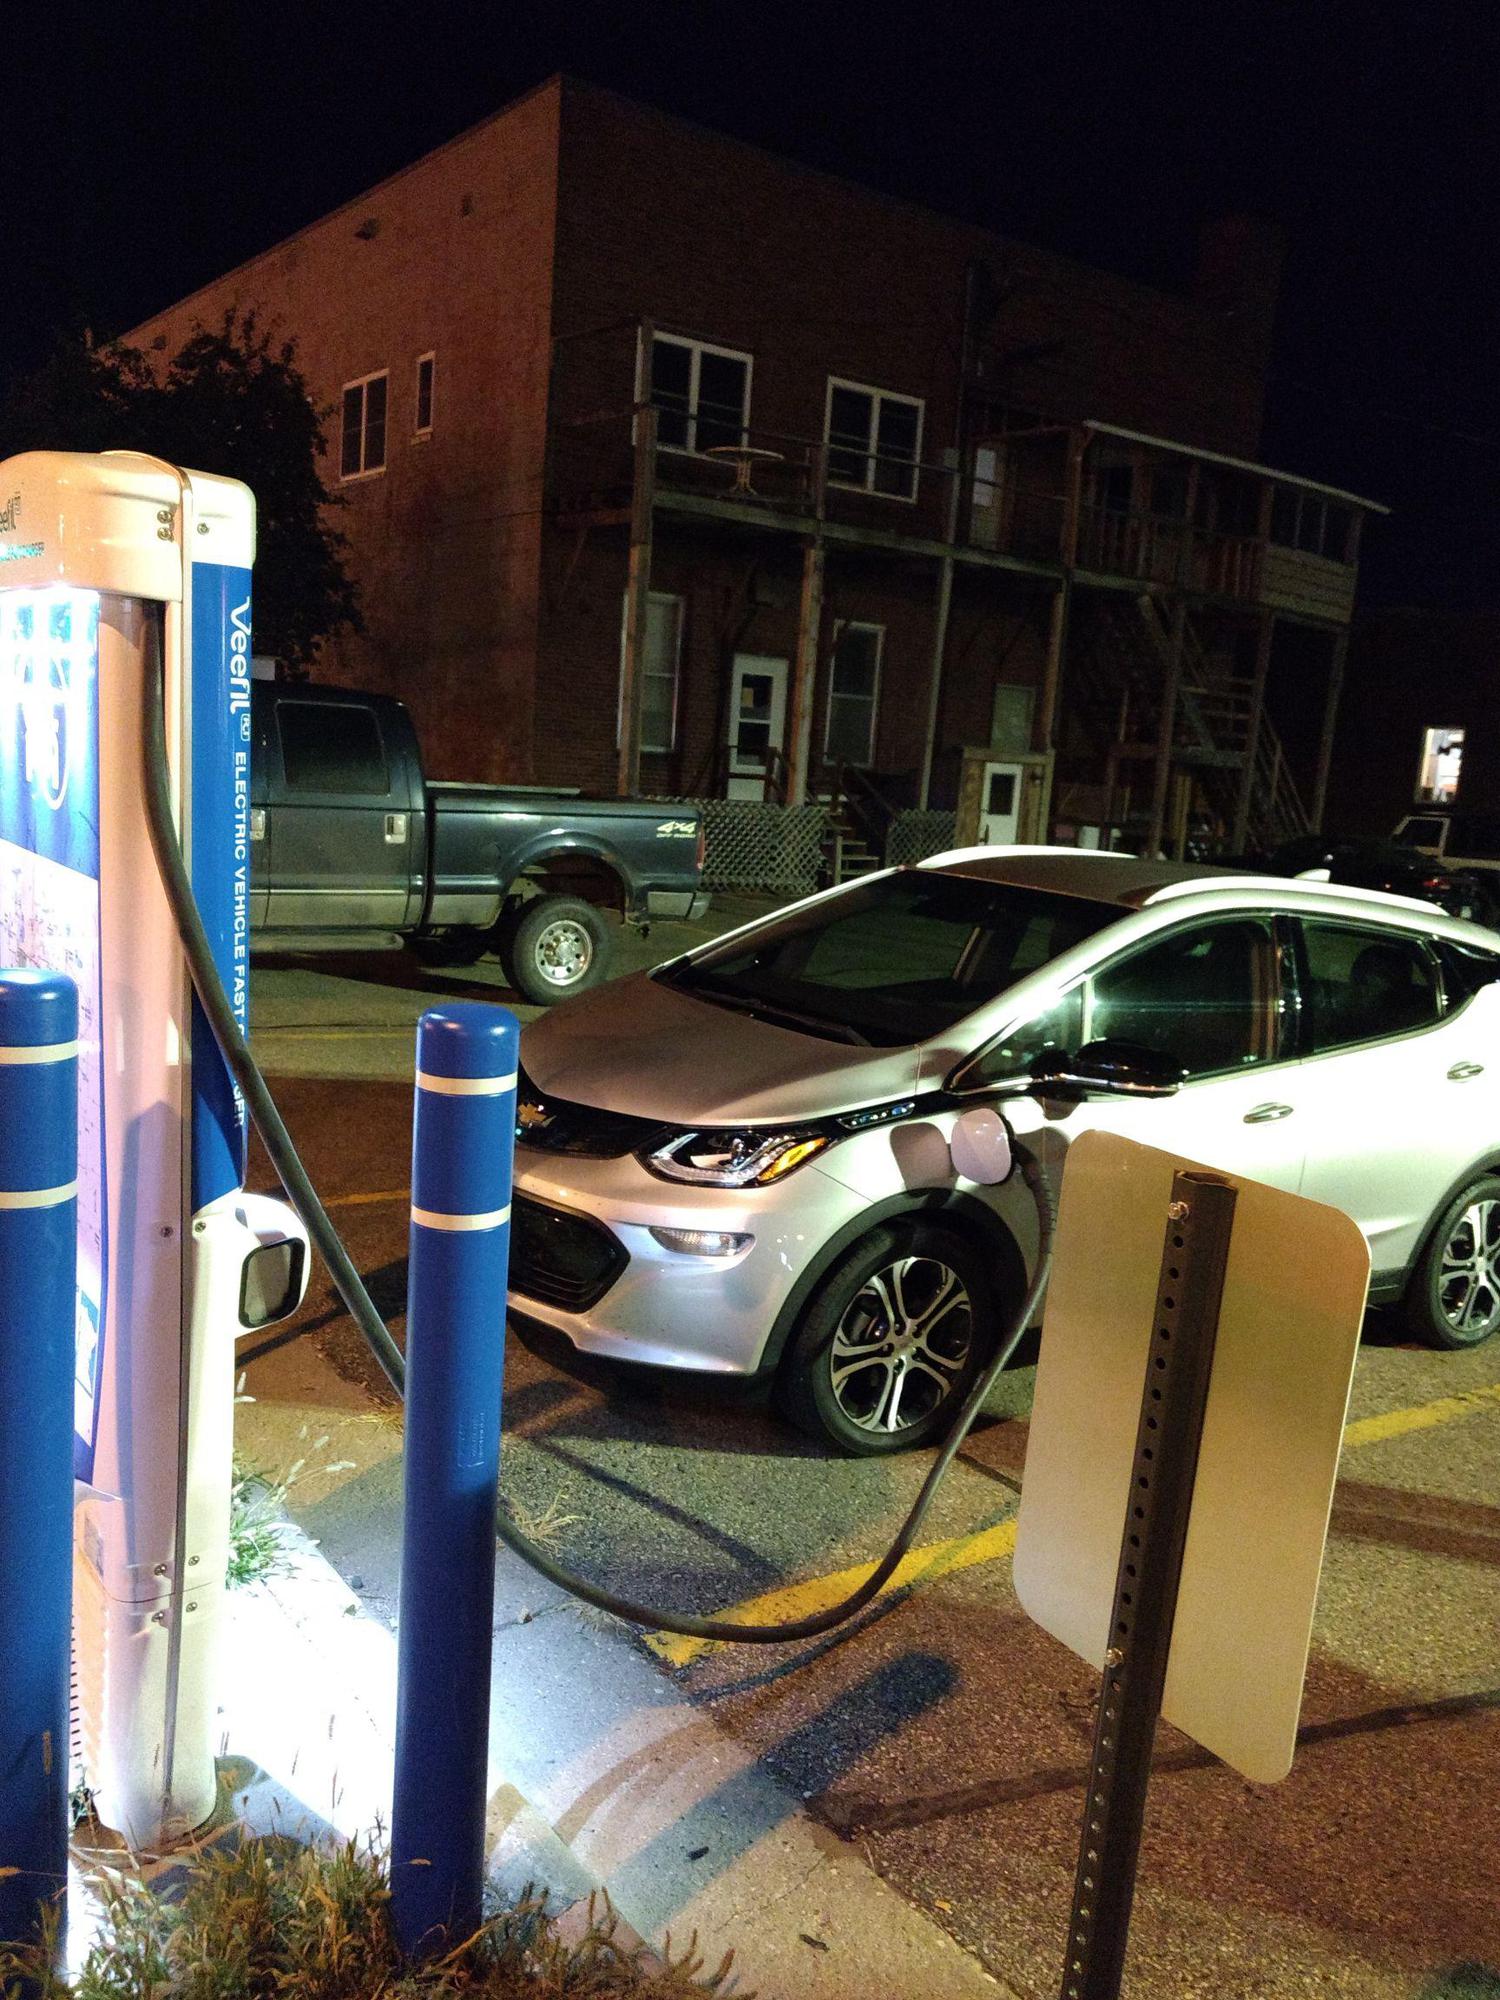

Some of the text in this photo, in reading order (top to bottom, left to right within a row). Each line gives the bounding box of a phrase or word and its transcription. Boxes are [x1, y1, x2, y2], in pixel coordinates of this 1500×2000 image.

[230, 596, 251, 715] Veefil
[234, 752, 247, 860] ELECTRIC
[233, 866, 247, 959] VEHICLE
[233, 964, 246, 1018] FAST
